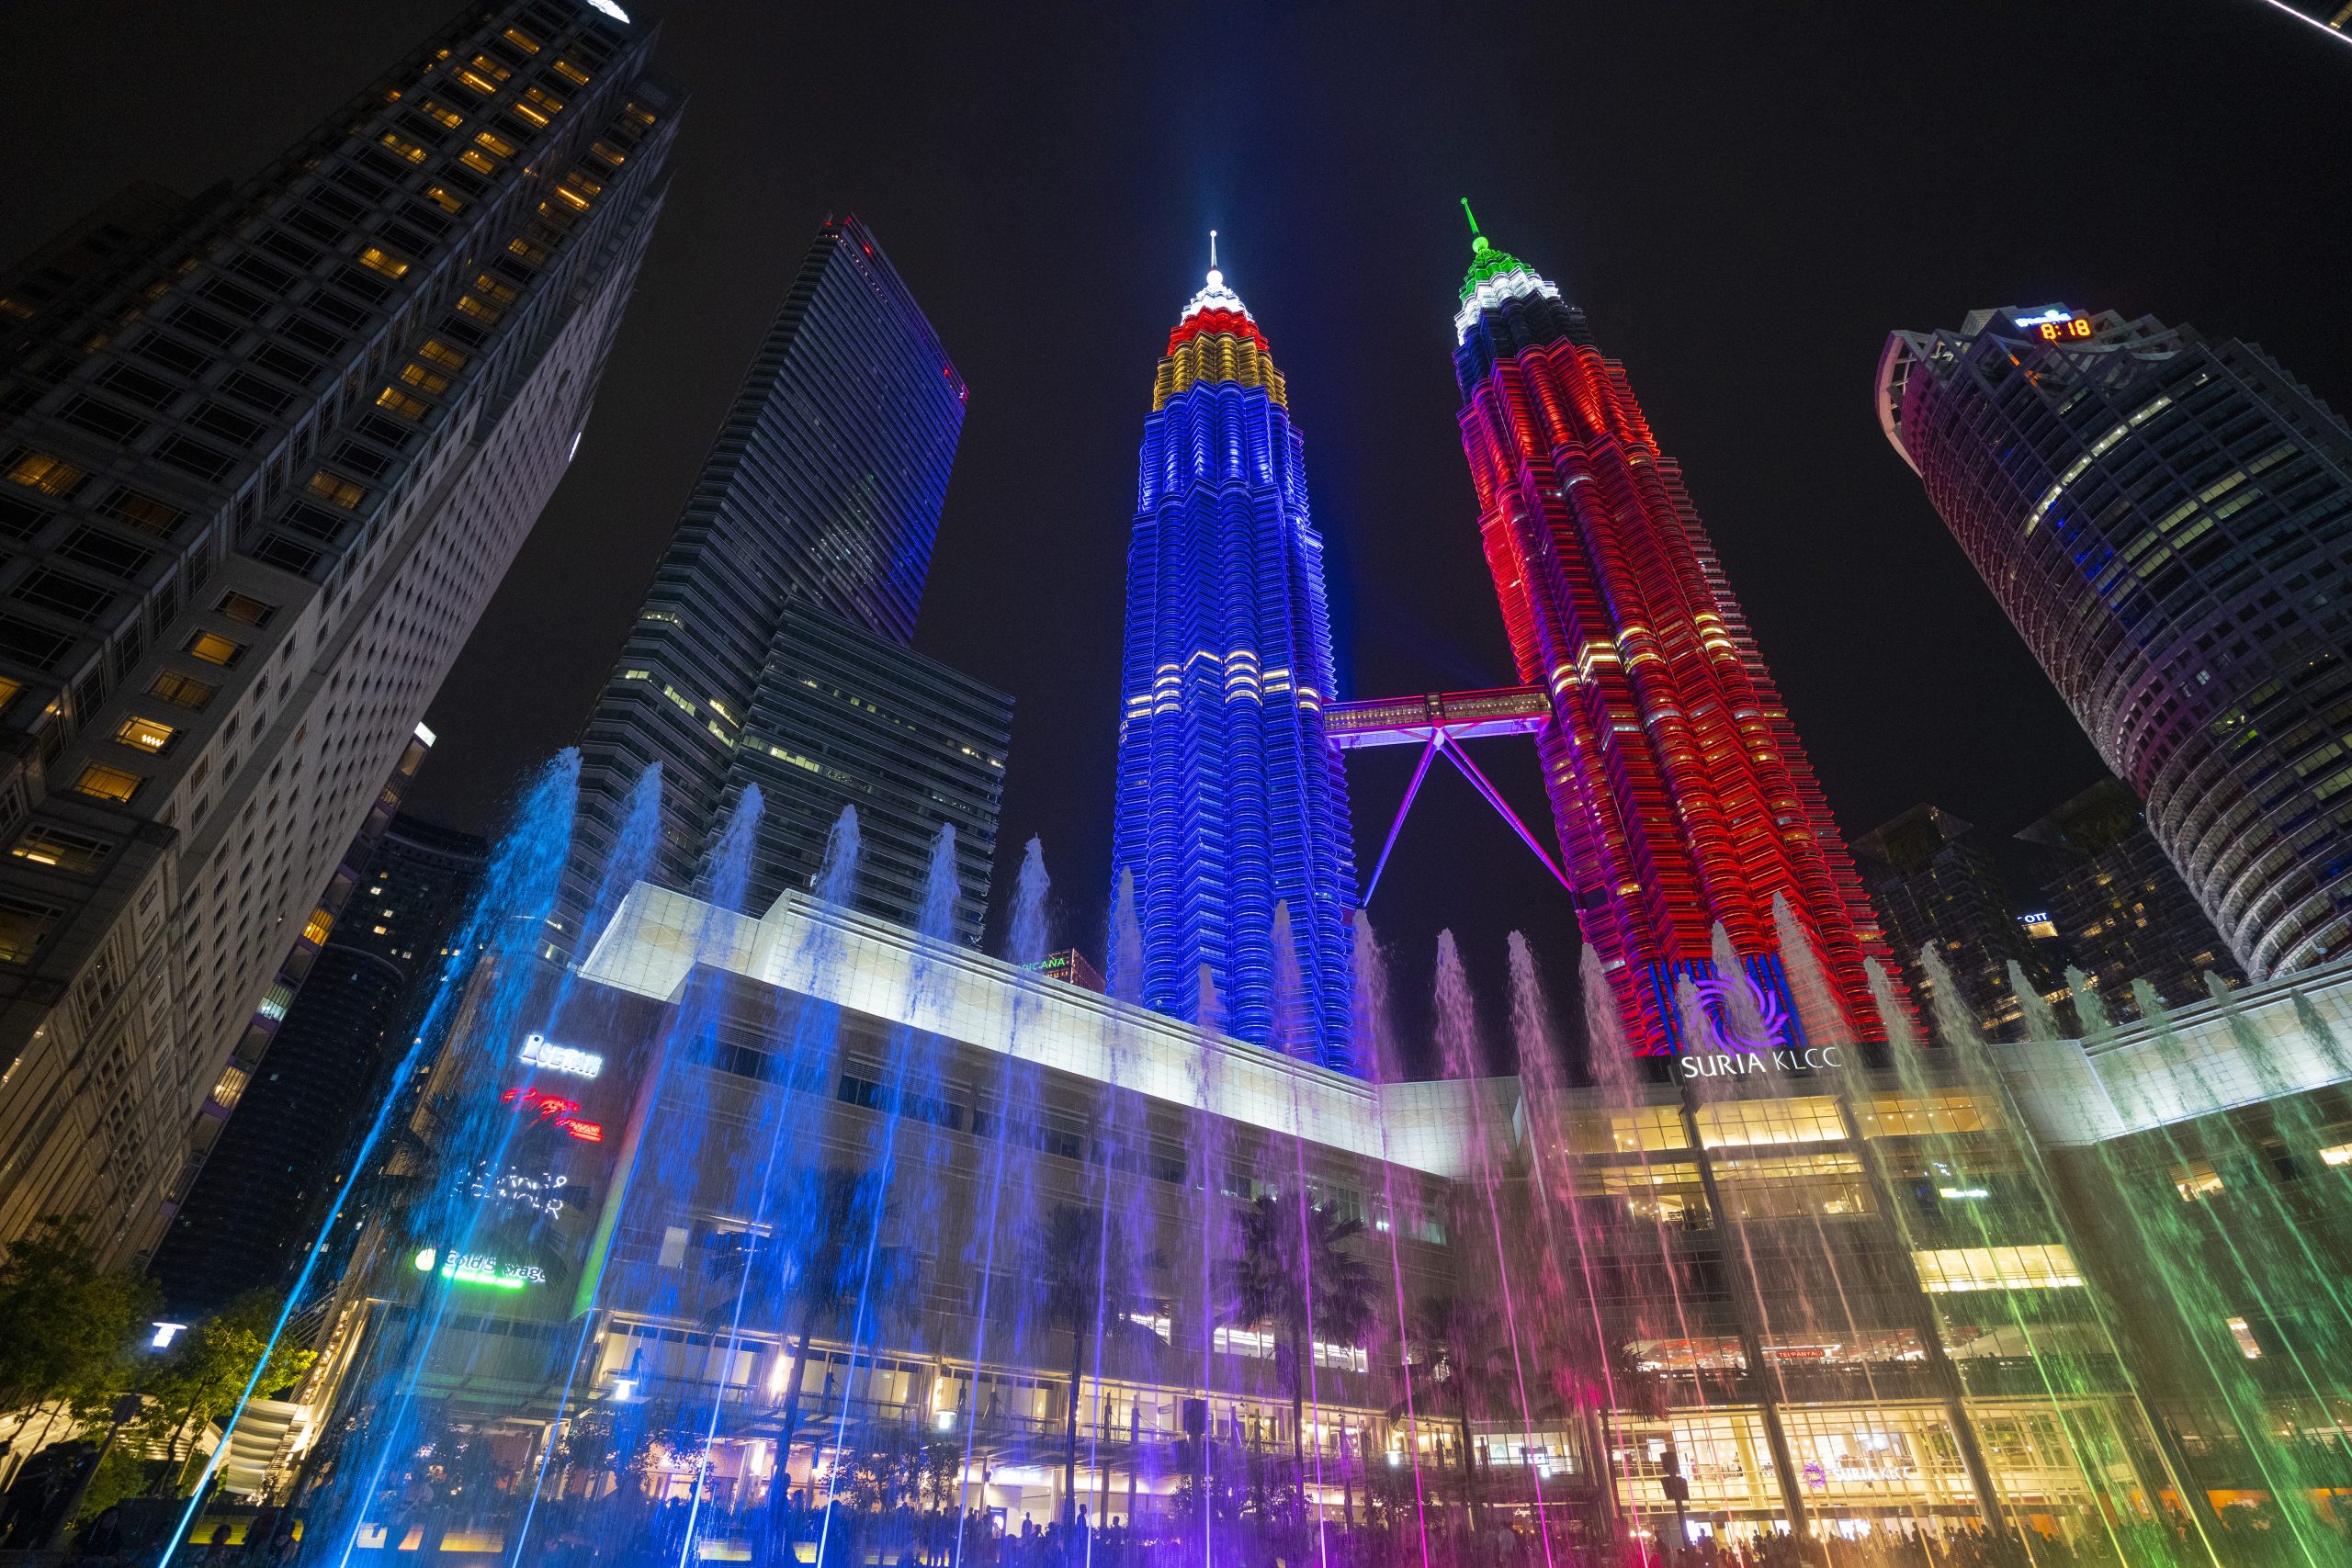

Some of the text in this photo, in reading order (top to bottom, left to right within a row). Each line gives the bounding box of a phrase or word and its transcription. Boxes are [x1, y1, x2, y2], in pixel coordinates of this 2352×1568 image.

[2041, 319, 2091, 340] 8:18
[2017, 912, 2047, 922] OTT
[522, 1034, 603, 1077] ISETAN
[1681, 1047, 1842, 1077] SURIA KLCC
[446, 1250, 482, 1270] Cold
[483, 1257, 547, 1283] Sorage
[1835, 1466, 1912, 1482] SURIA KLCC
